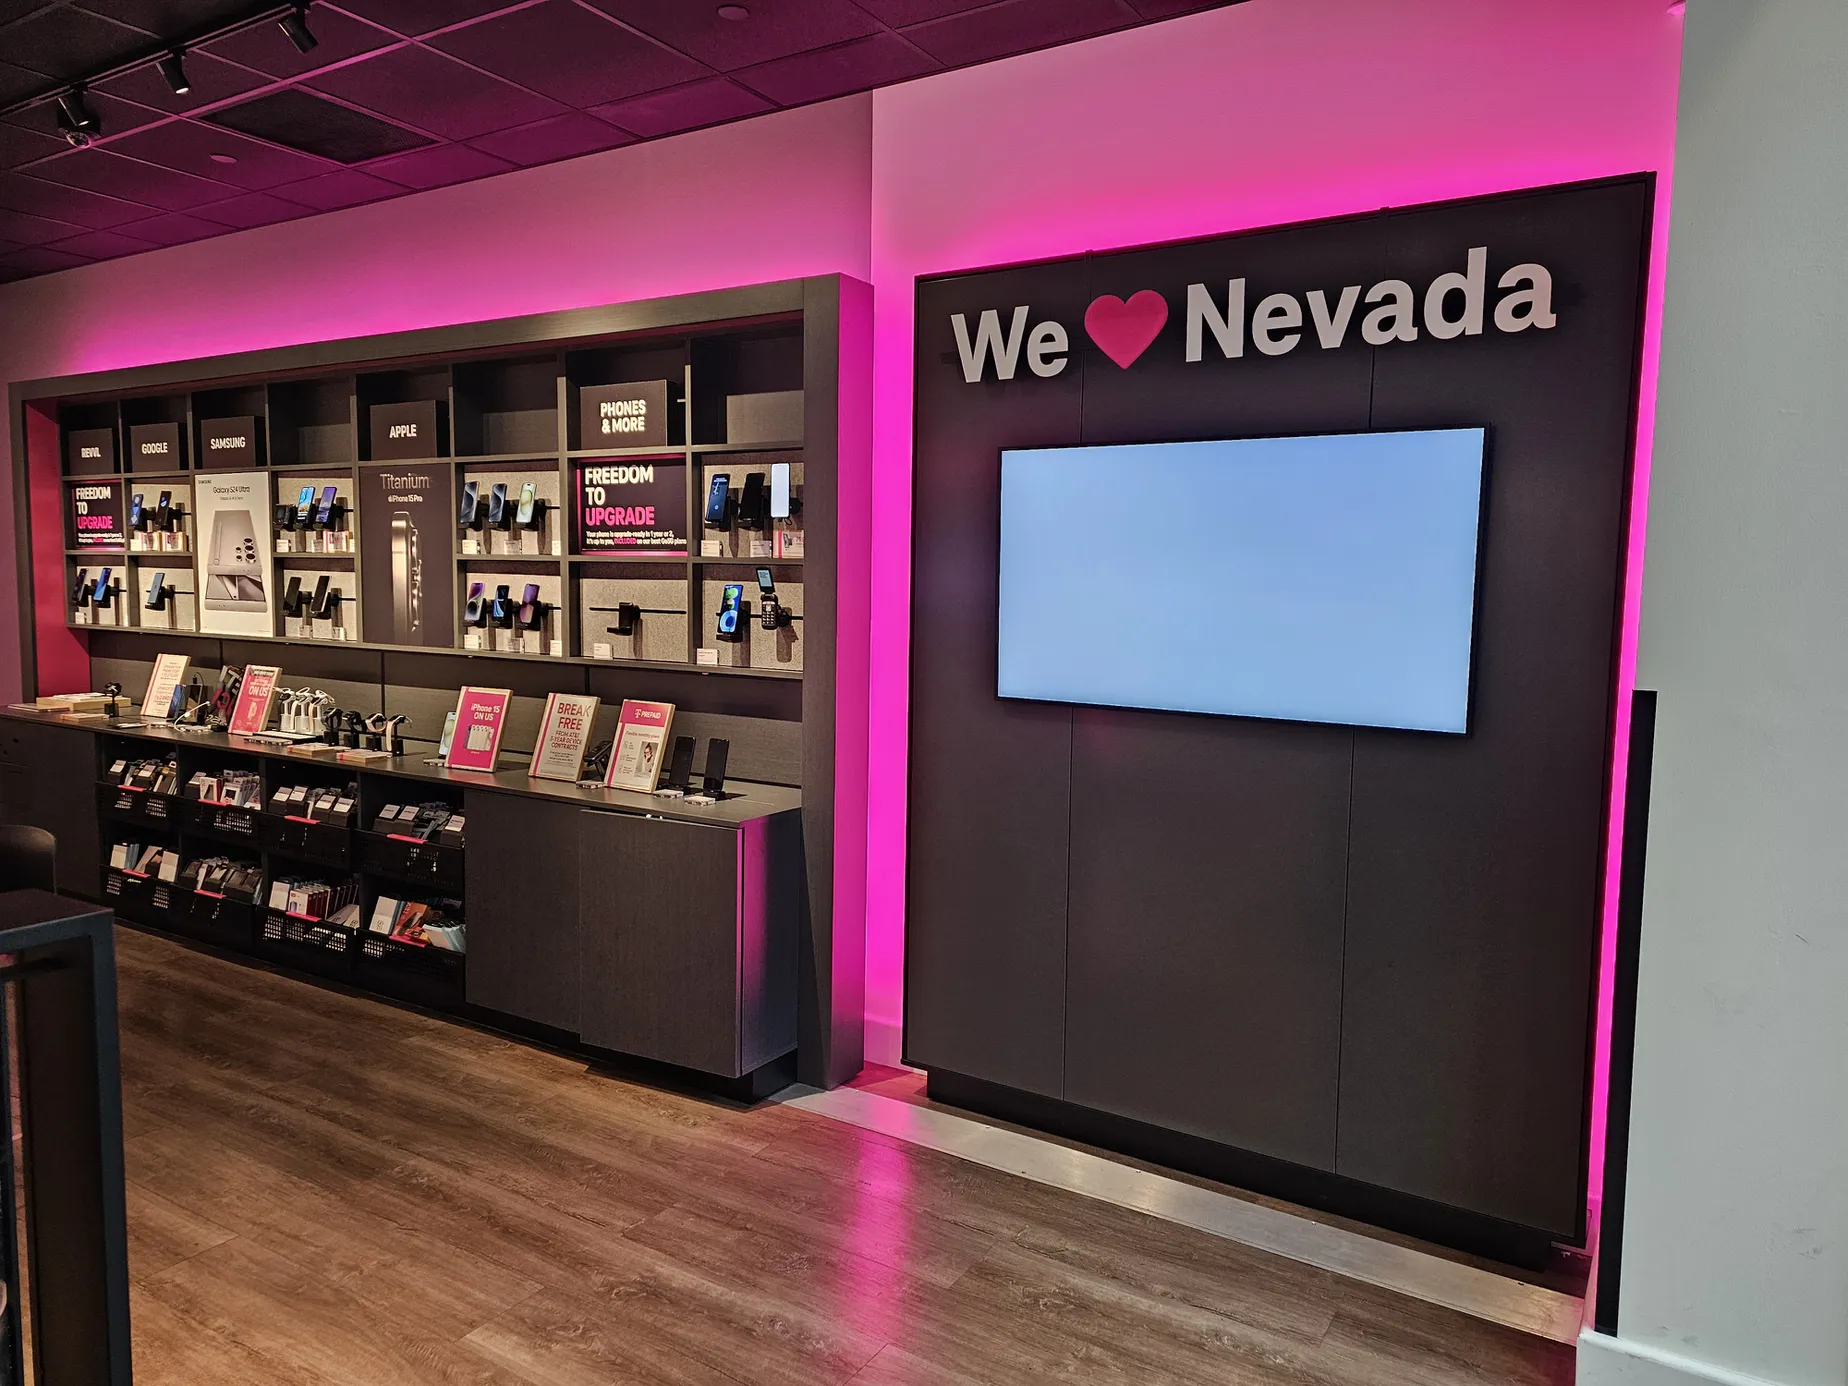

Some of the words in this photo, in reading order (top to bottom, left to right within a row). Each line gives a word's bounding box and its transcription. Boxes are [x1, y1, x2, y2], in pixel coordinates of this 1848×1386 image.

[951, 304, 1069, 383] We
[1185, 246, 1557, 363] Nevada
[600, 399, 647, 418] PHONES
[389, 423, 417, 438] APPLE
[601, 418, 611, 434] &
[611, 416, 645, 433] MORE
[141, 442, 168, 454] GOOGLE
[210, 436, 246, 450] SAMSUNG
[380, 472, 430, 490] Titanium
[584, 464, 654, 485] FREEDOM
[75, 486, 111, 500] FREEDOM
[212, 486, 230, 494] Galaxy
[585, 486, 606, 506] TO
[392, 494, 408, 502] iPhone
[408, 494, 414, 502] 15
[413, 494, 423, 502] Pro
[76, 501, 88, 515] TO
[77, 515, 113, 529] UPGRADE
[585, 506, 655, 526] UPGRADE
[614, 531, 646, 539] upgrade-ready
[248, 685, 259, 696] ON
[259, 686, 269, 697] US
[470, 703, 492, 713] iPhone
[493, 705, 501, 713] 15
[557, 702, 592, 717] BREAK
[641, 709, 662, 719] PREPAID
[473, 712, 484, 720] ON
[484, 713, 494, 721] US
[557, 717, 583, 731] FREE
[551, 742, 579, 751] CONTRACTS
[565, 737, 583, 746] DEVICE
